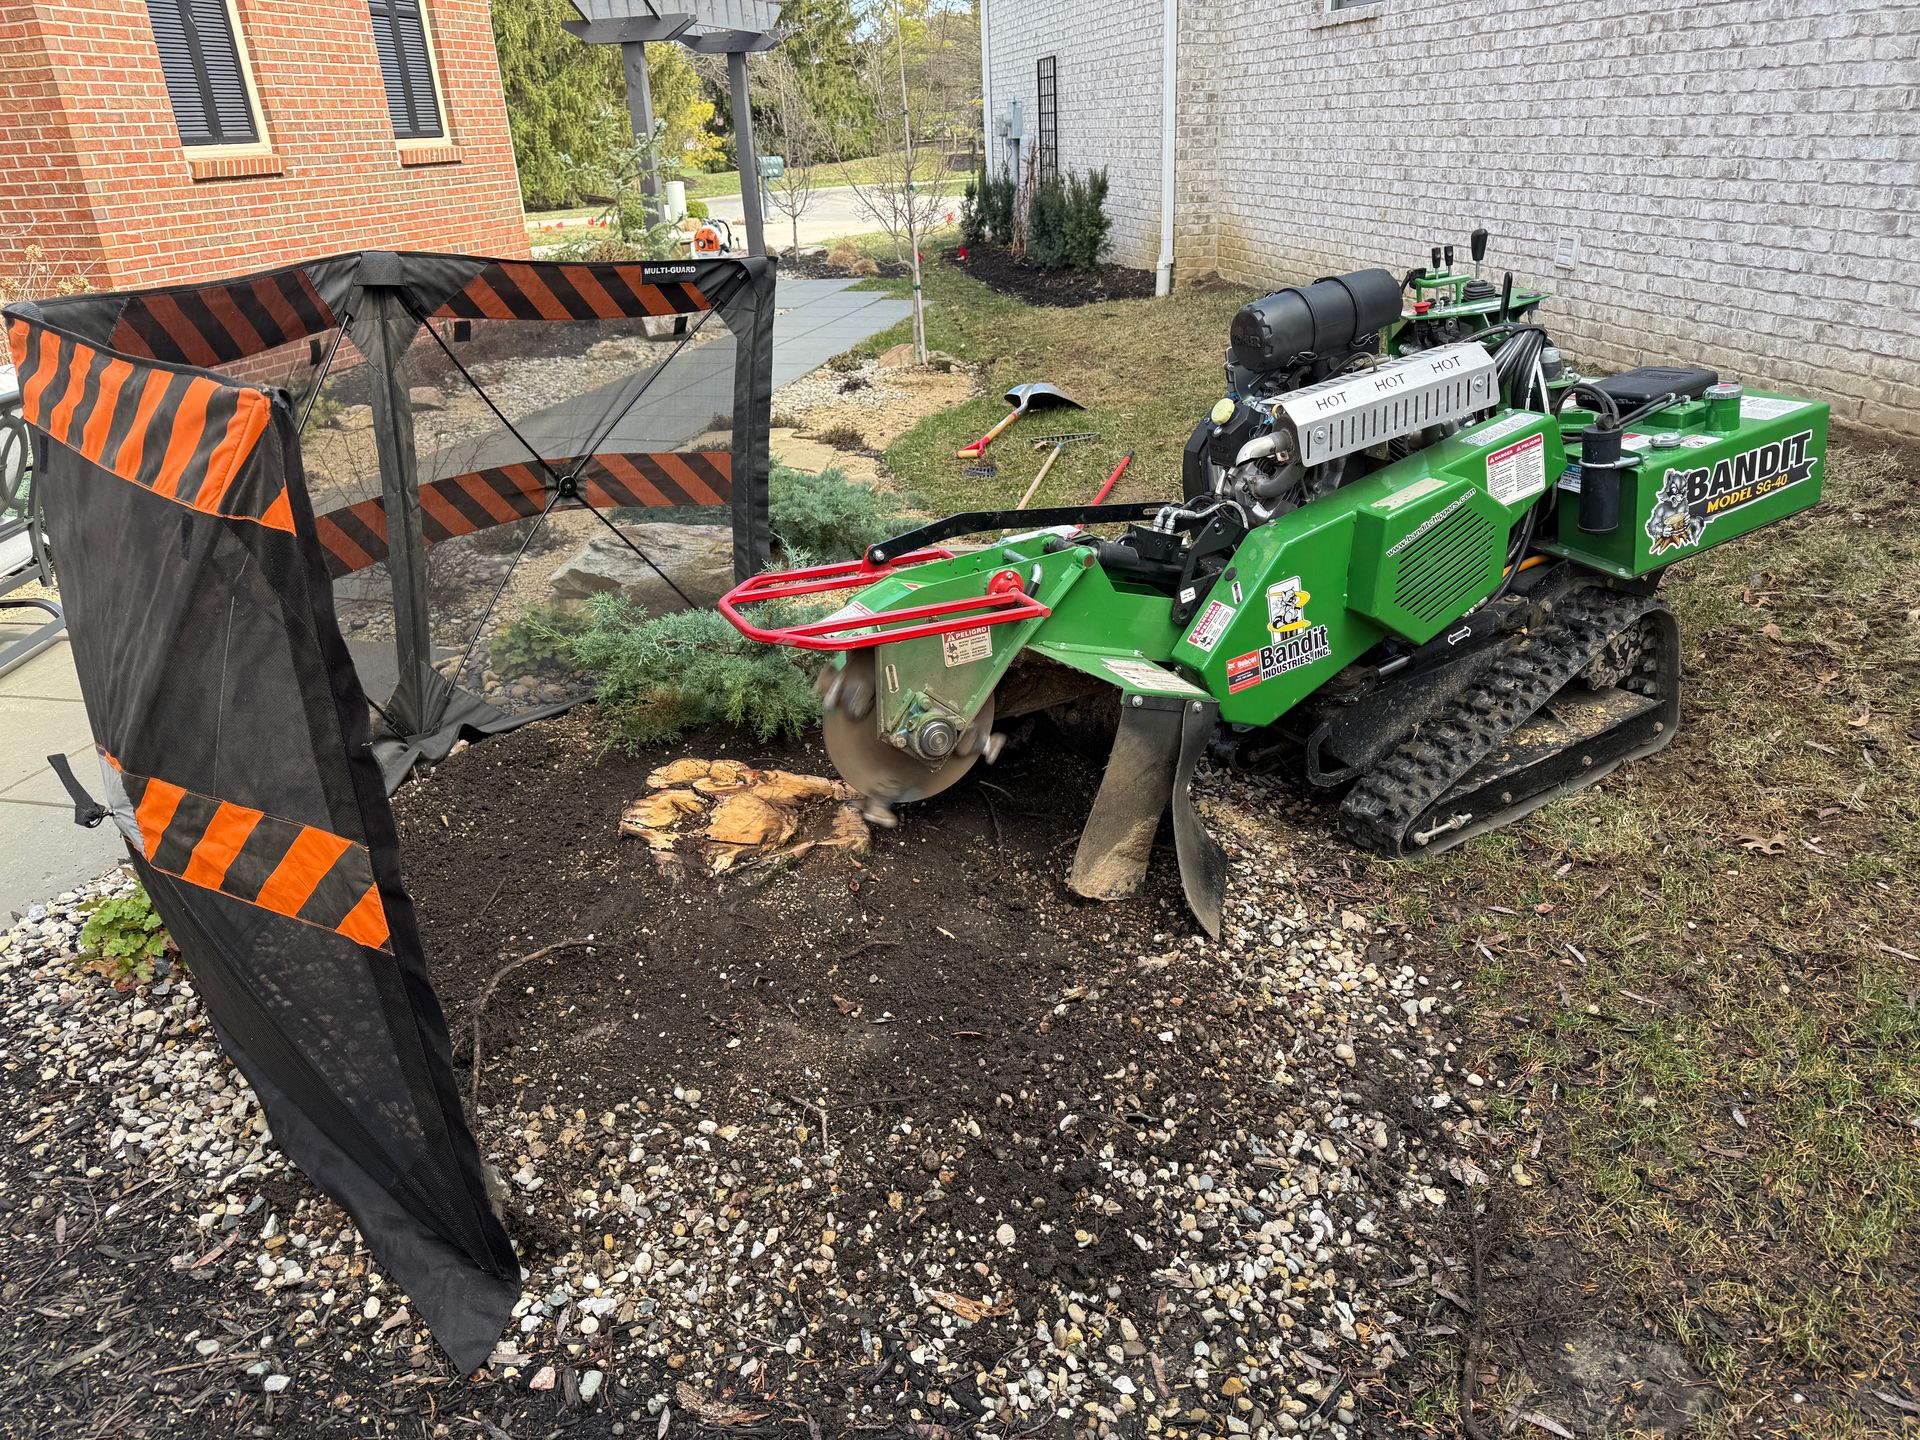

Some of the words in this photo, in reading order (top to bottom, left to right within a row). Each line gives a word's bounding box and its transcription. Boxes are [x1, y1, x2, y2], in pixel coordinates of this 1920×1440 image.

[644, 266, 697, 275] MULTI-GUARD
[1316, 391, 1348, 411] HOT
[1374, 373, 1405, 392] HOT
[1430, 355, 1462, 374] HOT
[1686, 430, 1813, 501] BANDIT
[1706, 487, 1752, 513] MODEL
[1756, 473, 1789, 495] SG-40
[1386, 487, 1477, 557] www.banditchippers.com
[955, 626, 987, 639] PELIGRO
[1195, 604, 1215, 630] DANGER
[1199, 605, 1220, 634] PELIGRO
[1260, 625, 1329, 671] Bandit
[1262, 653, 1313, 680] INDUSTRIES,
[1314, 646, 1332, 660] INC.
